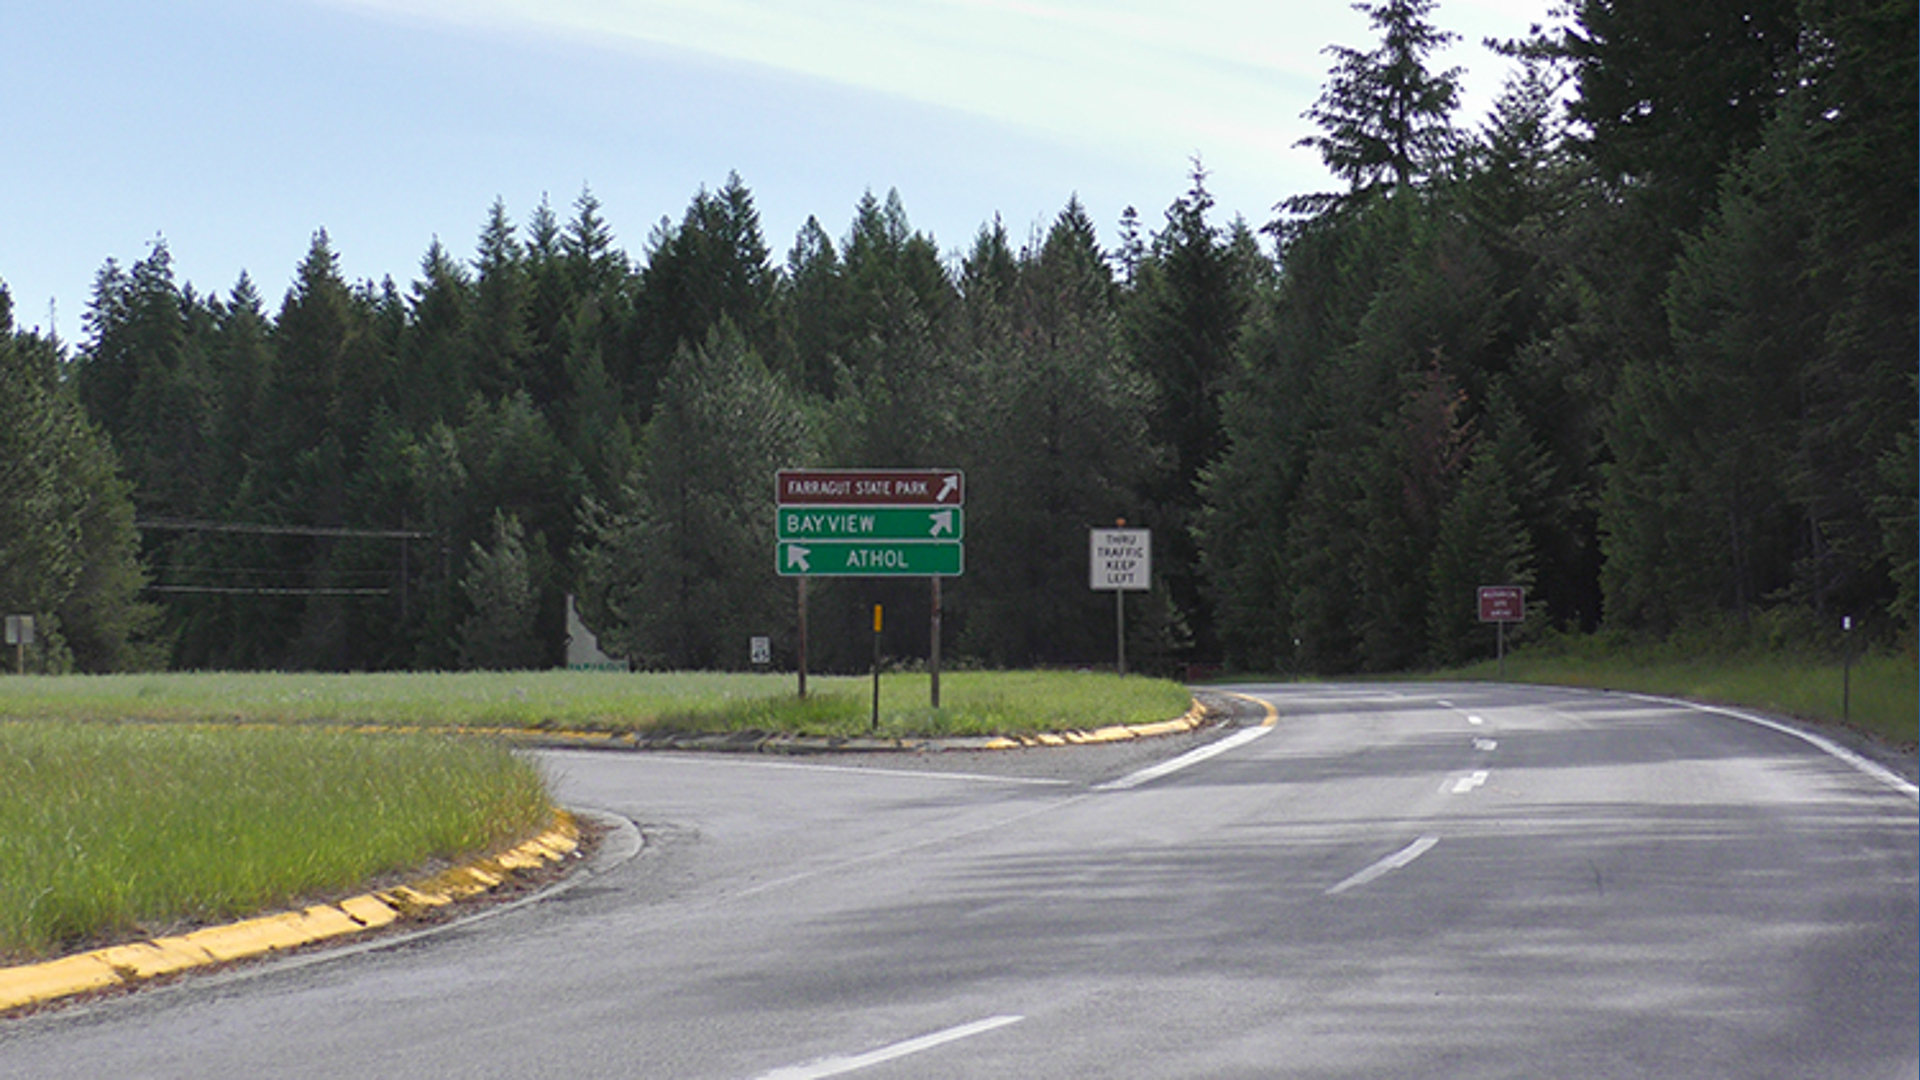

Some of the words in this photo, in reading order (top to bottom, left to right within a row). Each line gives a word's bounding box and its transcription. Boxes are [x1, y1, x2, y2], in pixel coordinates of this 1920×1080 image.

[788, 481, 850, 495] FARRAGUT
[856, 481, 891, 495] STATE
[895, 481, 928, 495] PARK
[787, 514, 875, 532] BAYVIEW
[1106, 534, 1136, 545] THRU
[1098, 547, 1144, 558] TRAFFIC
[846, 549, 908, 568] ATHOL
[1106, 560, 1136, 571] KEEP
[1107, 573, 1134, 583] LEFT
